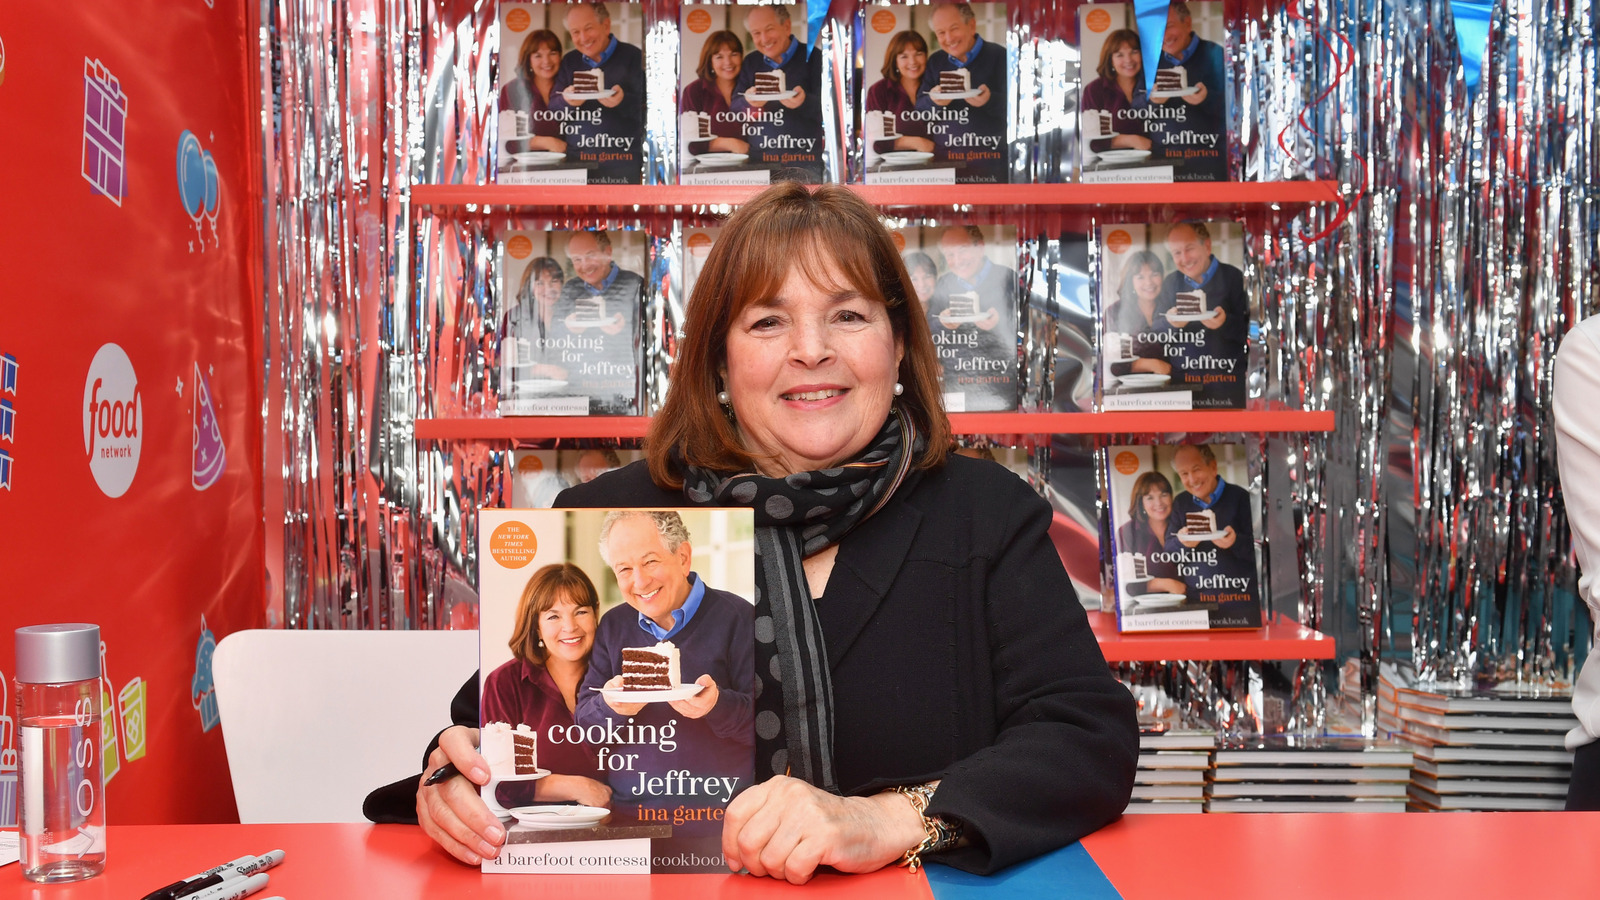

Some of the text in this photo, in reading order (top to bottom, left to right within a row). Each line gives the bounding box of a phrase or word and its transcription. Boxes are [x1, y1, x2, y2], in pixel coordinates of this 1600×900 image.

[534, 107, 602, 125] cooking
[716, 108, 784, 126] cooking
[901, 106, 969, 124] cooking
[1118, 105, 1186, 122] cooking
[560, 122, 582, 134] for
[742, 123, 764, 136] for
[926, 122, 949, 134] for
[1144, 120, 1166, 132] for
[577, 133, 634, 151] Jeffrey
[760, 135, 816, 152] Jeffrey
[945, 133, 1001, 150] Jeffrey
[1162, 130, 1219, 148] Jeffrey
[536, 334, 604, 352] cooking
[932, 330, 978, 348] oking
[1138, 328, 1205, 347] cooking
[562, 350, 584, 362] for
[937, 346, 959, 358] for
[1164, 344, 1185, 356] for
[579, 361, 634, 378] Jeffrey
[955, 357, 1010, 374] Jeffrey
[1181, 356, 1237, 373] Jeffrey
[88, 377, 139, 464] food
[101, 445, 132, 458] network
[1151, 548, 1218, 566] cooking
[1177, 564, 1199, 576] for
[1196, 574, 1250, 592] Jeffrey
[548, 717, 677, 752] cooking
[597, 747, 639, 771] for
[75, 697, 94, 858] VOSS
[632, 770, 739, 802] Jeffrey
[638, 805, 724, 825] ina garte
[494, 854, 502, 866] a
[507, 853, 574, 866] barefoot
[579, 855, 648, 866] contessa
